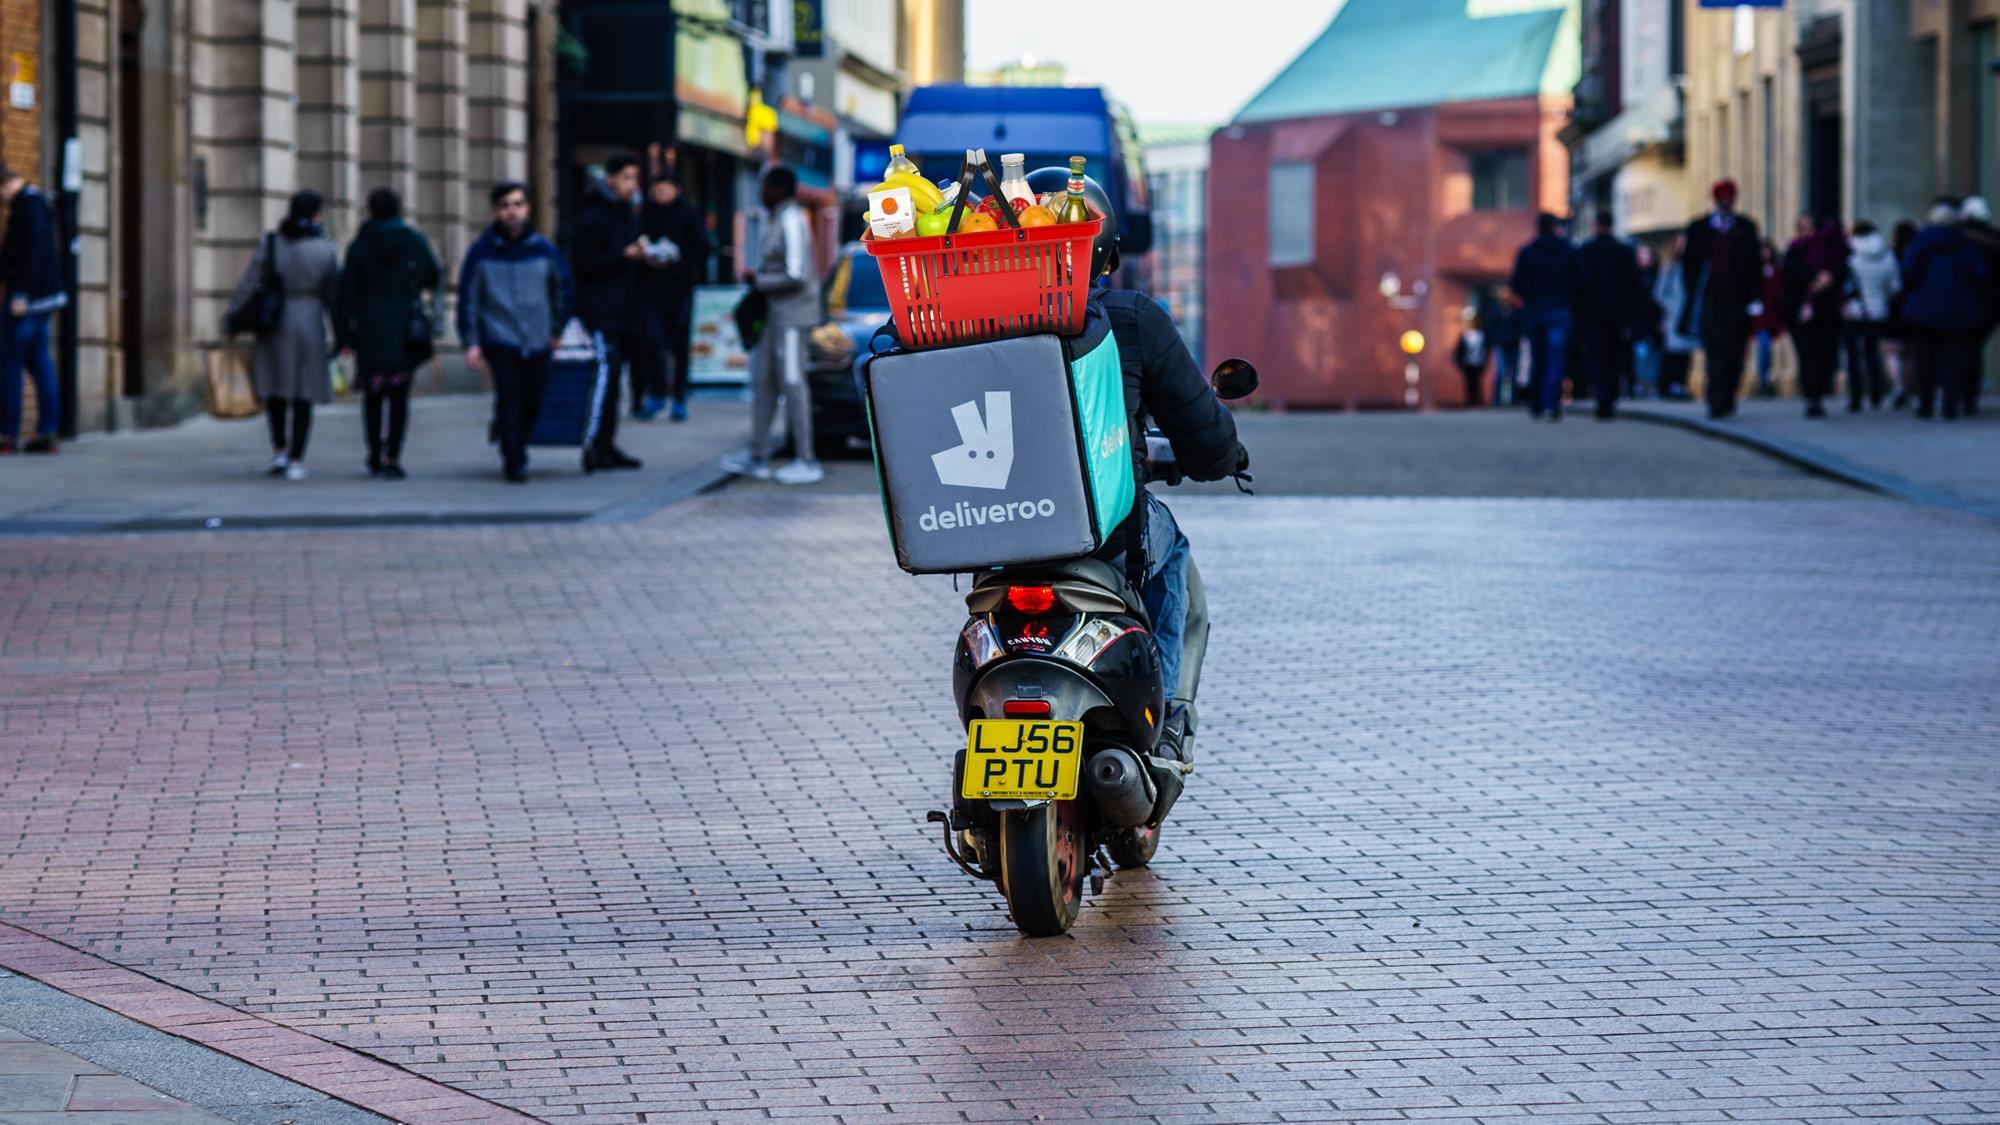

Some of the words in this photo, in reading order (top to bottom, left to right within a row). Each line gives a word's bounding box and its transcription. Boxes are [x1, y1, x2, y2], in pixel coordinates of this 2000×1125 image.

[919, 498, 1056, 532] deliveroo
[974, 724, 1076, 754] LJ56
[983, 758, 1060, 789] PTU
